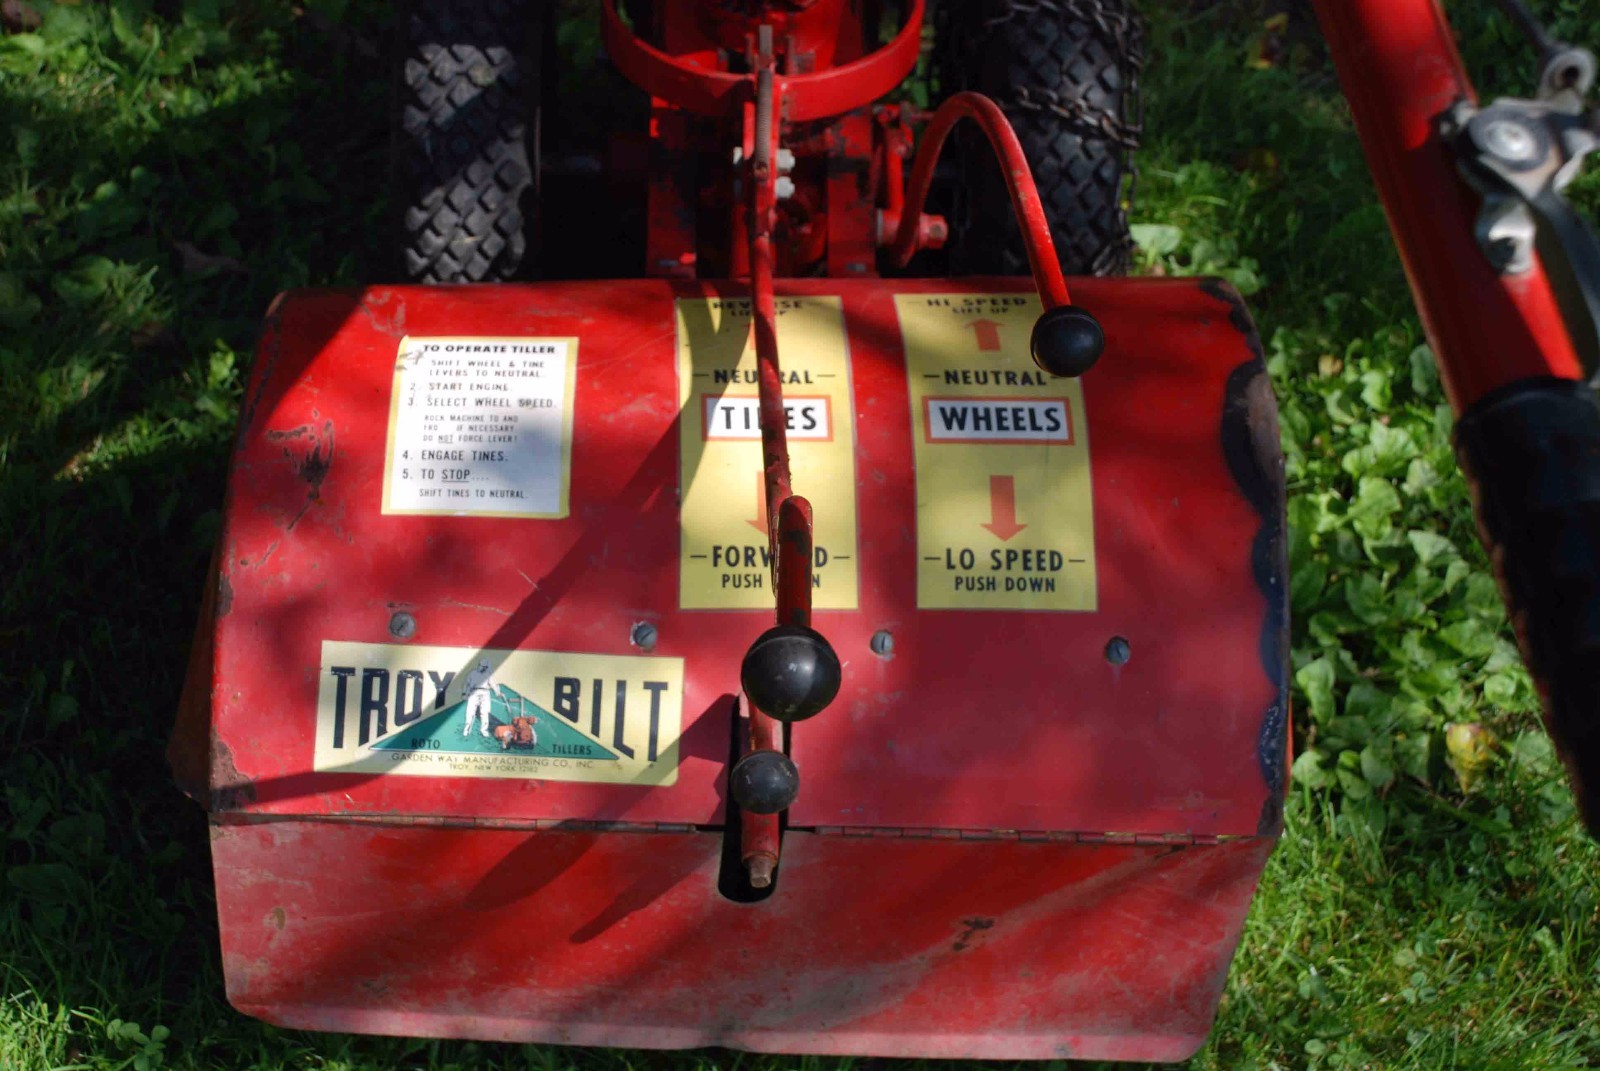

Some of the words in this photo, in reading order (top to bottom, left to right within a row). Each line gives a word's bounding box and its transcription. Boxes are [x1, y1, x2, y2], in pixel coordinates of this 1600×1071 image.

[445, 345, 507, 353] OPERATE
[512, 346, 555, 354] TILLER
[713, 369, 814, 384] NEURAL
[945, 370, 1047, 386] NEUTRAL
[429, 383, 463, 391] START
[427, 398, 467, 407] SELECT
[475, 398, 511, 408] WHEEL
[720, 406, 817, 430] TIES
[939, 406, 1061, 432] WHEELS
[421, 450, 465, 461] ENGAGE
[472, 450, 508, 462] TINES.
[421, 469, 434, 479] TO
[419, 489, 442, 497] SHIFT
[447, 489, 470, 498] TINES
[475, 490, 485, 498] TO
[712, 545, 828, 567] FORWD
[946, 548, 975, 570] LO
[991, 549, 1063, 572] SPEED
[722, 574, 762, 588] PUSH
[955, 576, 996, 591] PUSH
[1005, 577, 1055, 592] DOWN
[331, 666, 456, 749] TROY
[553, 676, 668, 762] BILT
[411, 738, 440, 749] ROTO
[552, 744, 592, 756] TILLERS
[391, 752, 433, 762] GARDEN
[463, 756, 549, 767] MANUFACTURING
